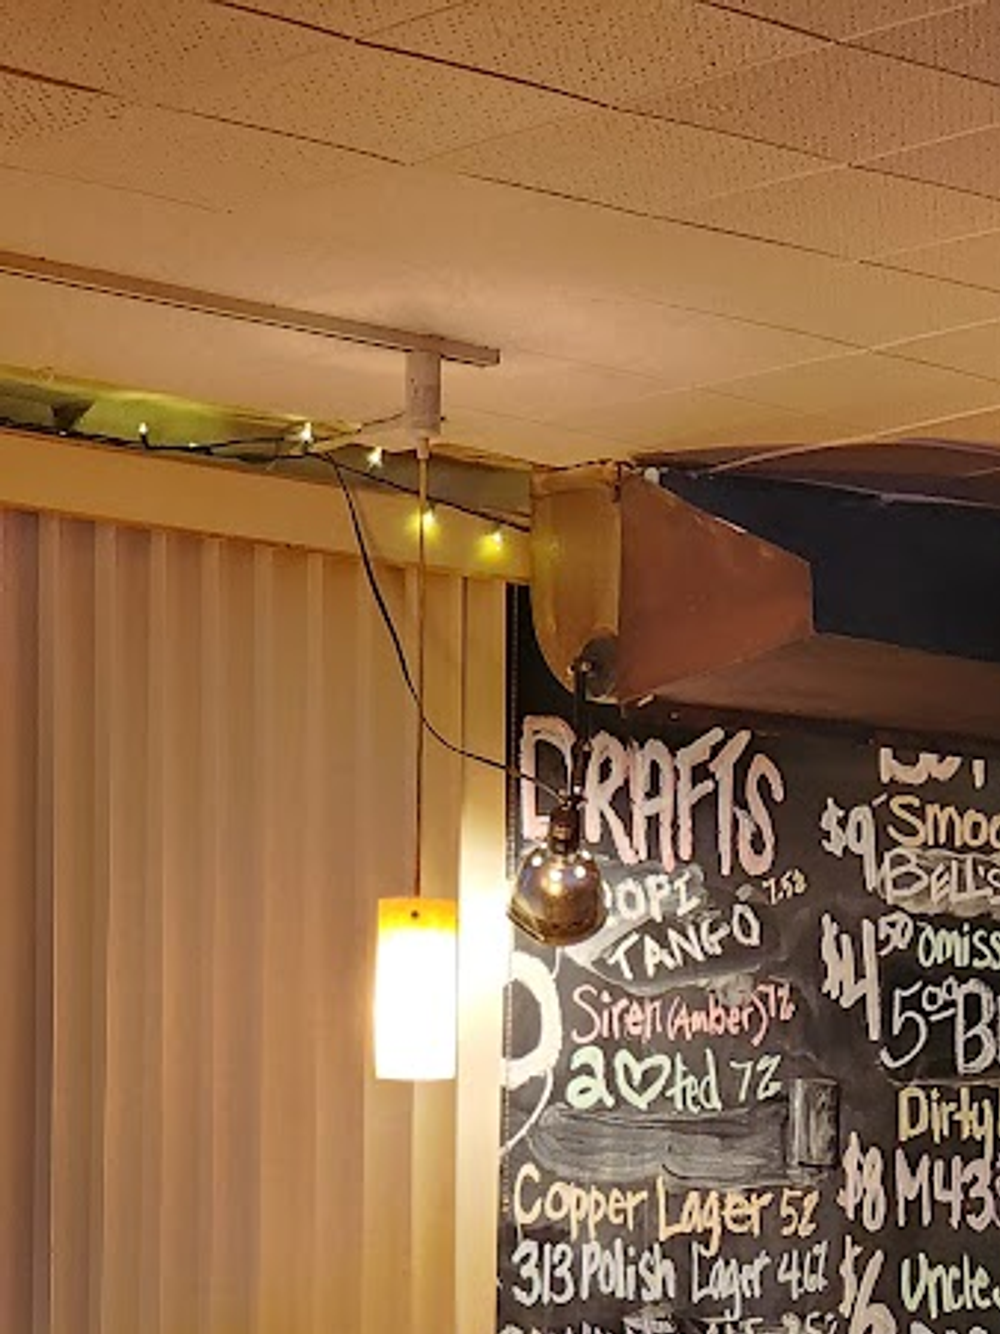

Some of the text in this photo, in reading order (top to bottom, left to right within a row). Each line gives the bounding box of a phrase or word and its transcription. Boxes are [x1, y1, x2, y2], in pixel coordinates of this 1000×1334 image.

[520, 715, 785, 876] DRAFTS
[607, 904, 761, 980] TANGO
[571, 984, 663, 1046] Siren
[514, 1162, 649, 1242] Copper
[656, 1175, 774, 1259] Lager
[511, 1239, 575, 1307] 313
[579, 1237, 676, 1301] Polish
[901, 1252, 992, 1320] Uncle
